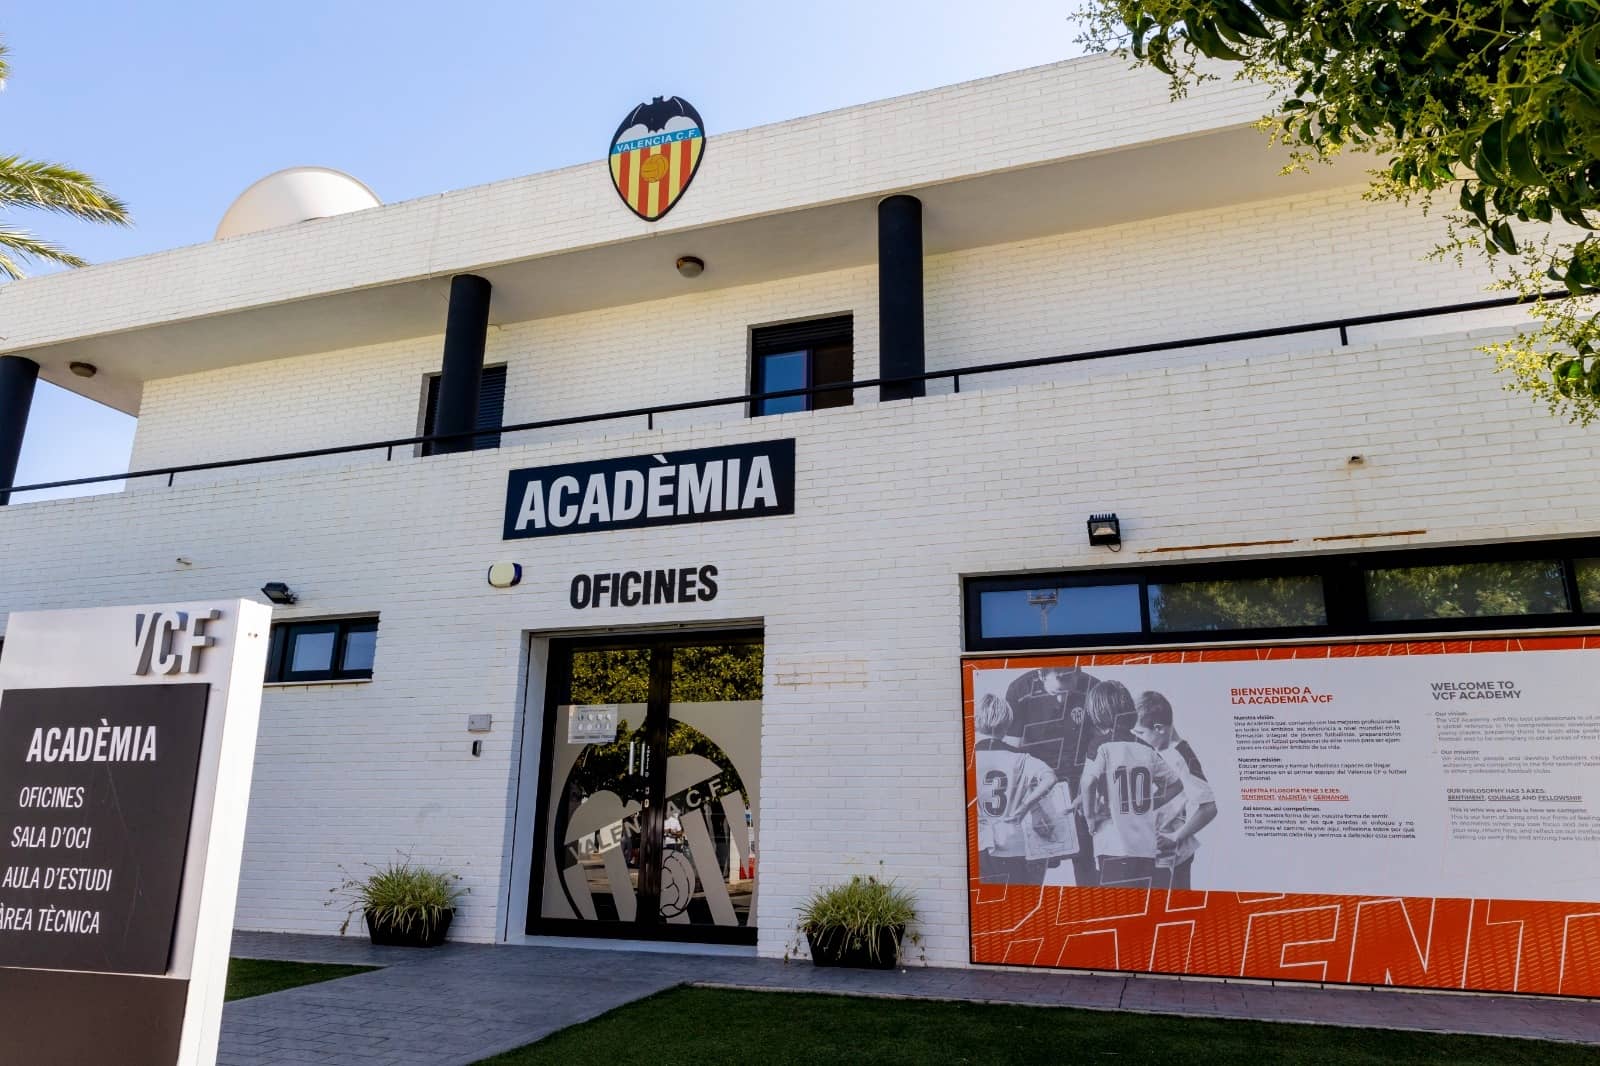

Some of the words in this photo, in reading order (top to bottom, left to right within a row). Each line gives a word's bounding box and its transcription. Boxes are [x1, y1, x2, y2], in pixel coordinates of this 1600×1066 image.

[616, 134, 673, 152] VALENCIA
[676, 129, 697, 140] C.F.
[514, 454, 778, 531] ACADÈMIA
[569, 565, 718, 609] OFICINES
[133, 608, 221, 676] VCF
[1231, 687, 1300, 696] BIENVENIDO
[1303, 686, 1312, 695] A
[1431, 682, 1495, 691] WELCOME
[1497, 681, 1514, 690] TO
[1432, 691, 1457, 701] VCF
[1459, 690, 1521, 700] ACADEMY
[1232, 696, 1246, 705] LA
[1248, 695, 1309, 705] ACADEMIA
[1311, 694, 1334, 703] VCF
[26, 718, 157, 762] ACADÈMIA
[19, 786, 85, 809] OFICINES
[983, 769, 1009, 817] 3
[1113, 765, 1152, 816] 10
[11, 826, 46, 849] SALA
[51, 826, 92, 849] D'OCI
[2, 867, 40, 889] AULA
[44, 867, 113, 892] D'ESTUDI
[38, 904, 100, 934] TÈCNICA
